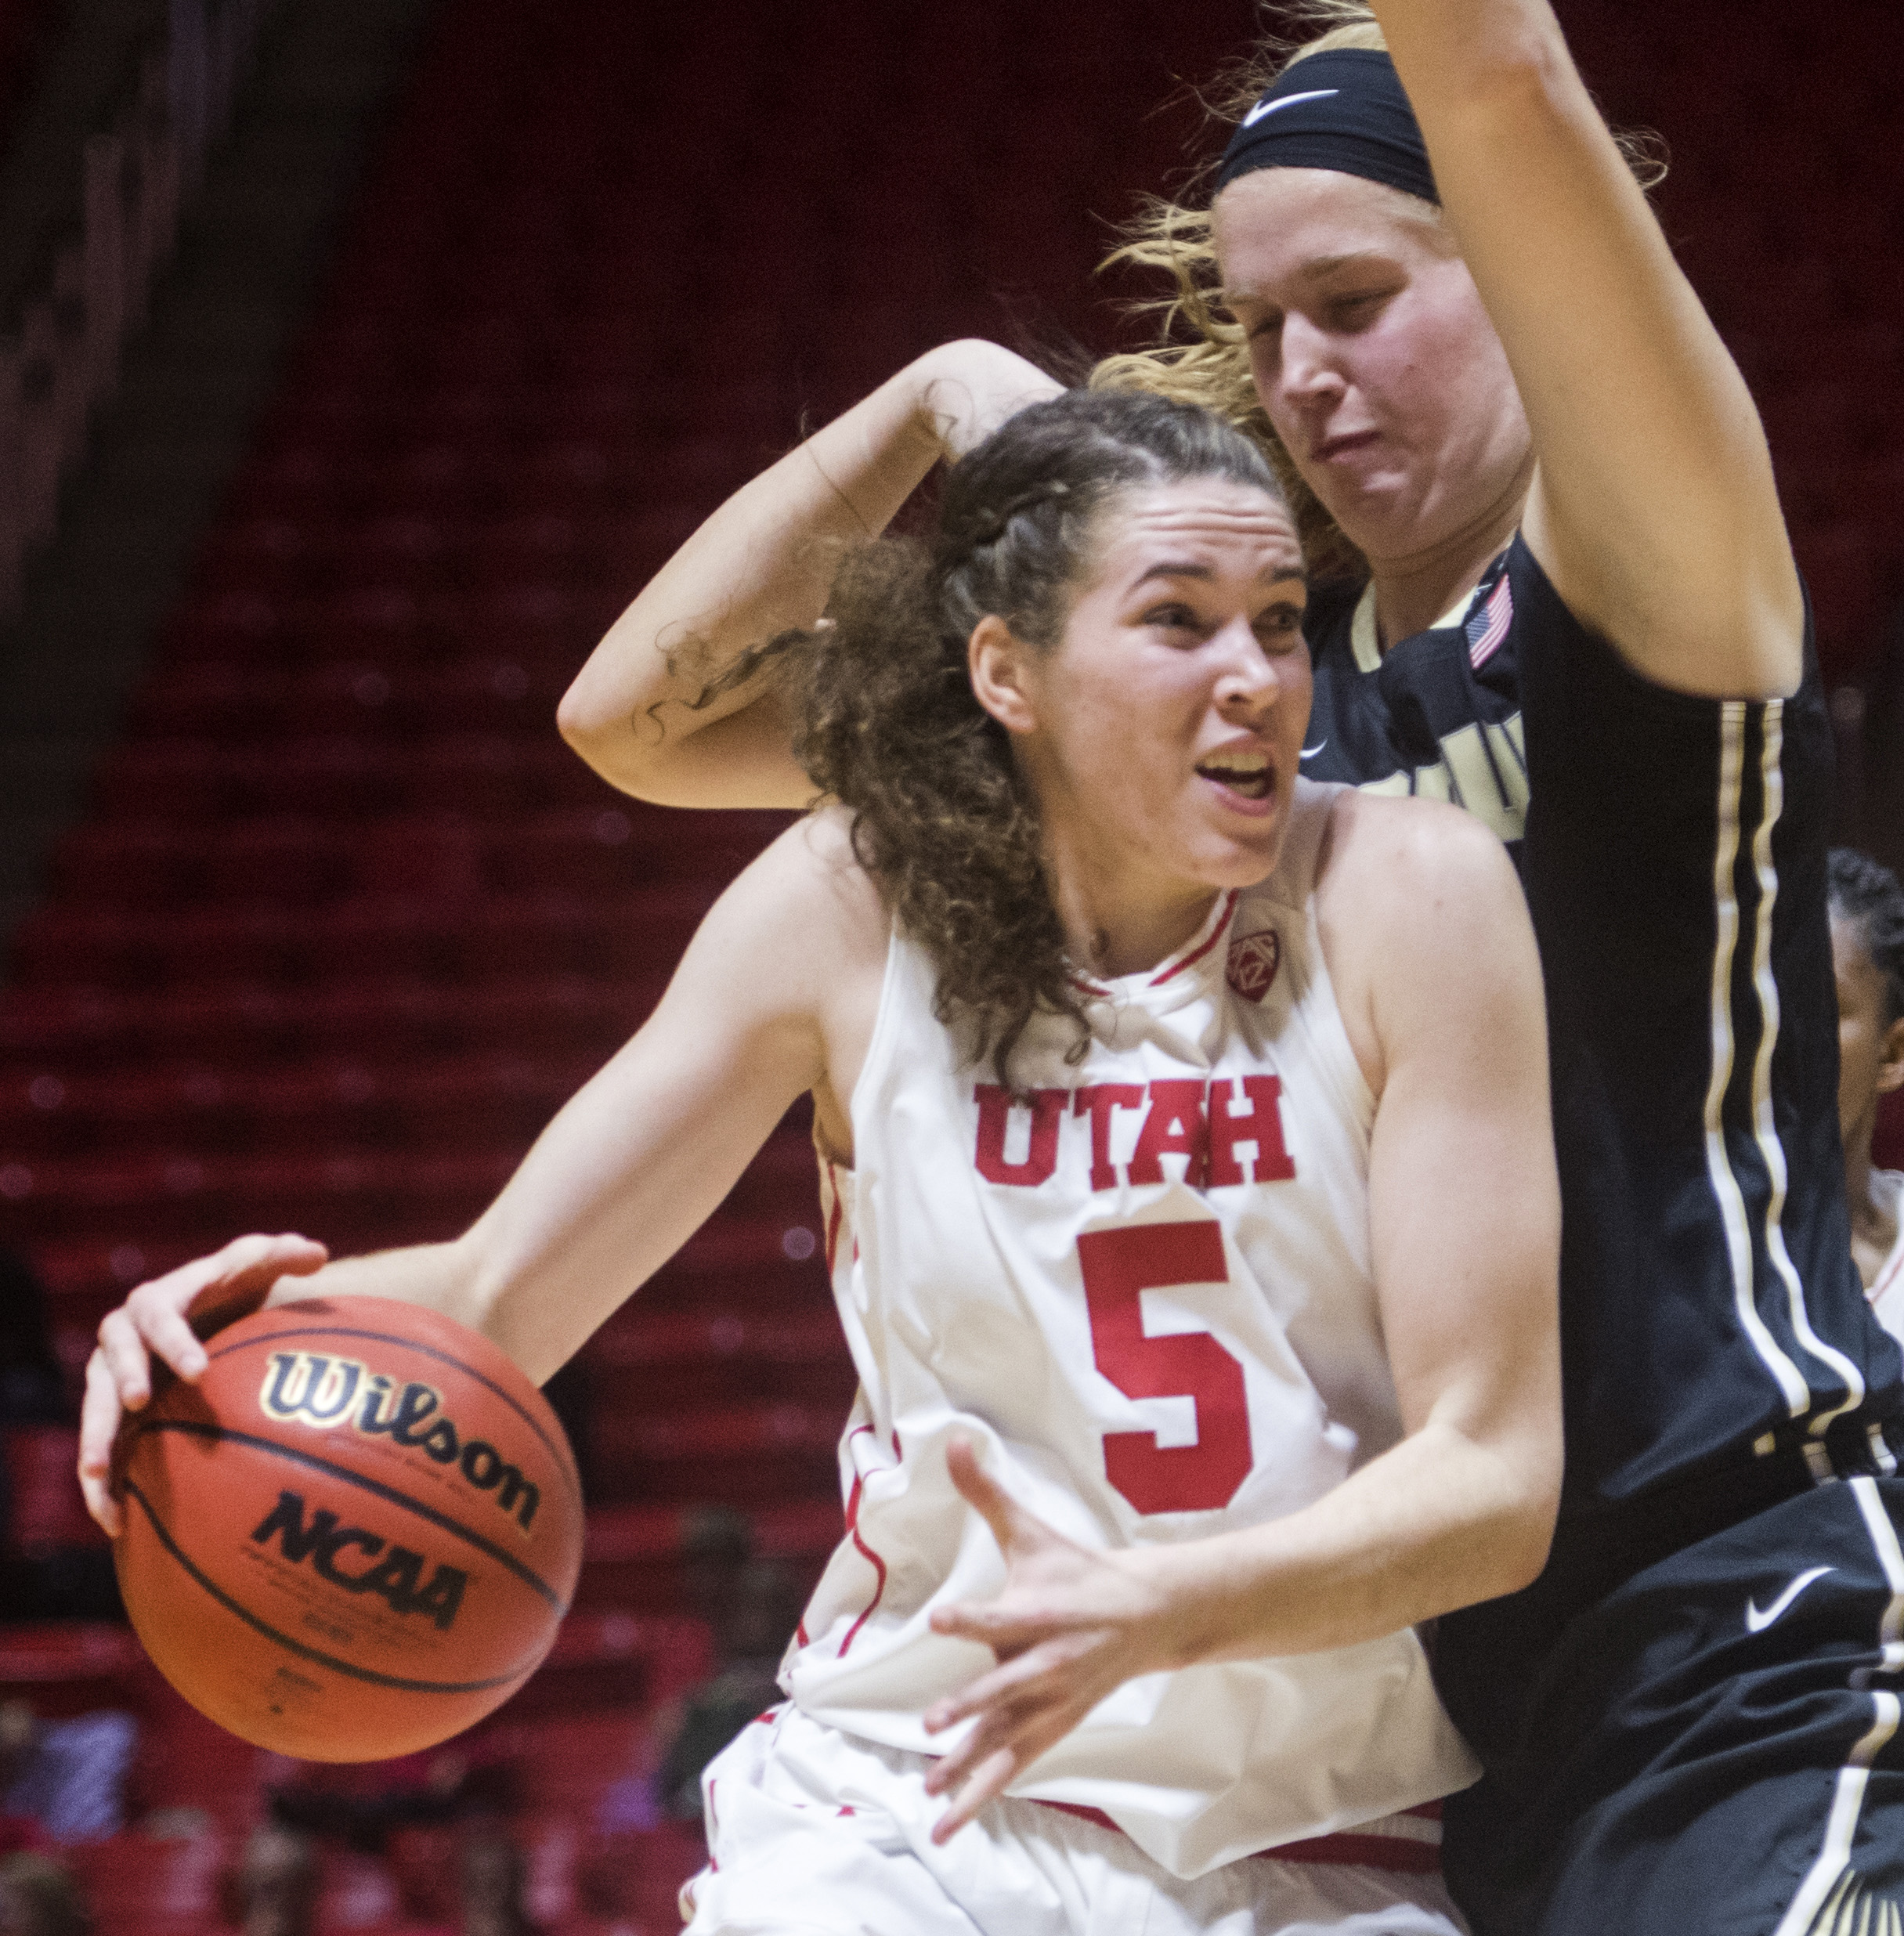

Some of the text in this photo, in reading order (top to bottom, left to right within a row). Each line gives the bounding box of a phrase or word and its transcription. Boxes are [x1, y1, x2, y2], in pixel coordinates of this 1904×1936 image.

[974, 1074, 1297, 1192] UTAH
[257, 1349, 542, 1535] Wilson
[1076, 1219, 1254, 1516] 5
[251, 1490, 470, 1631] NCAA
